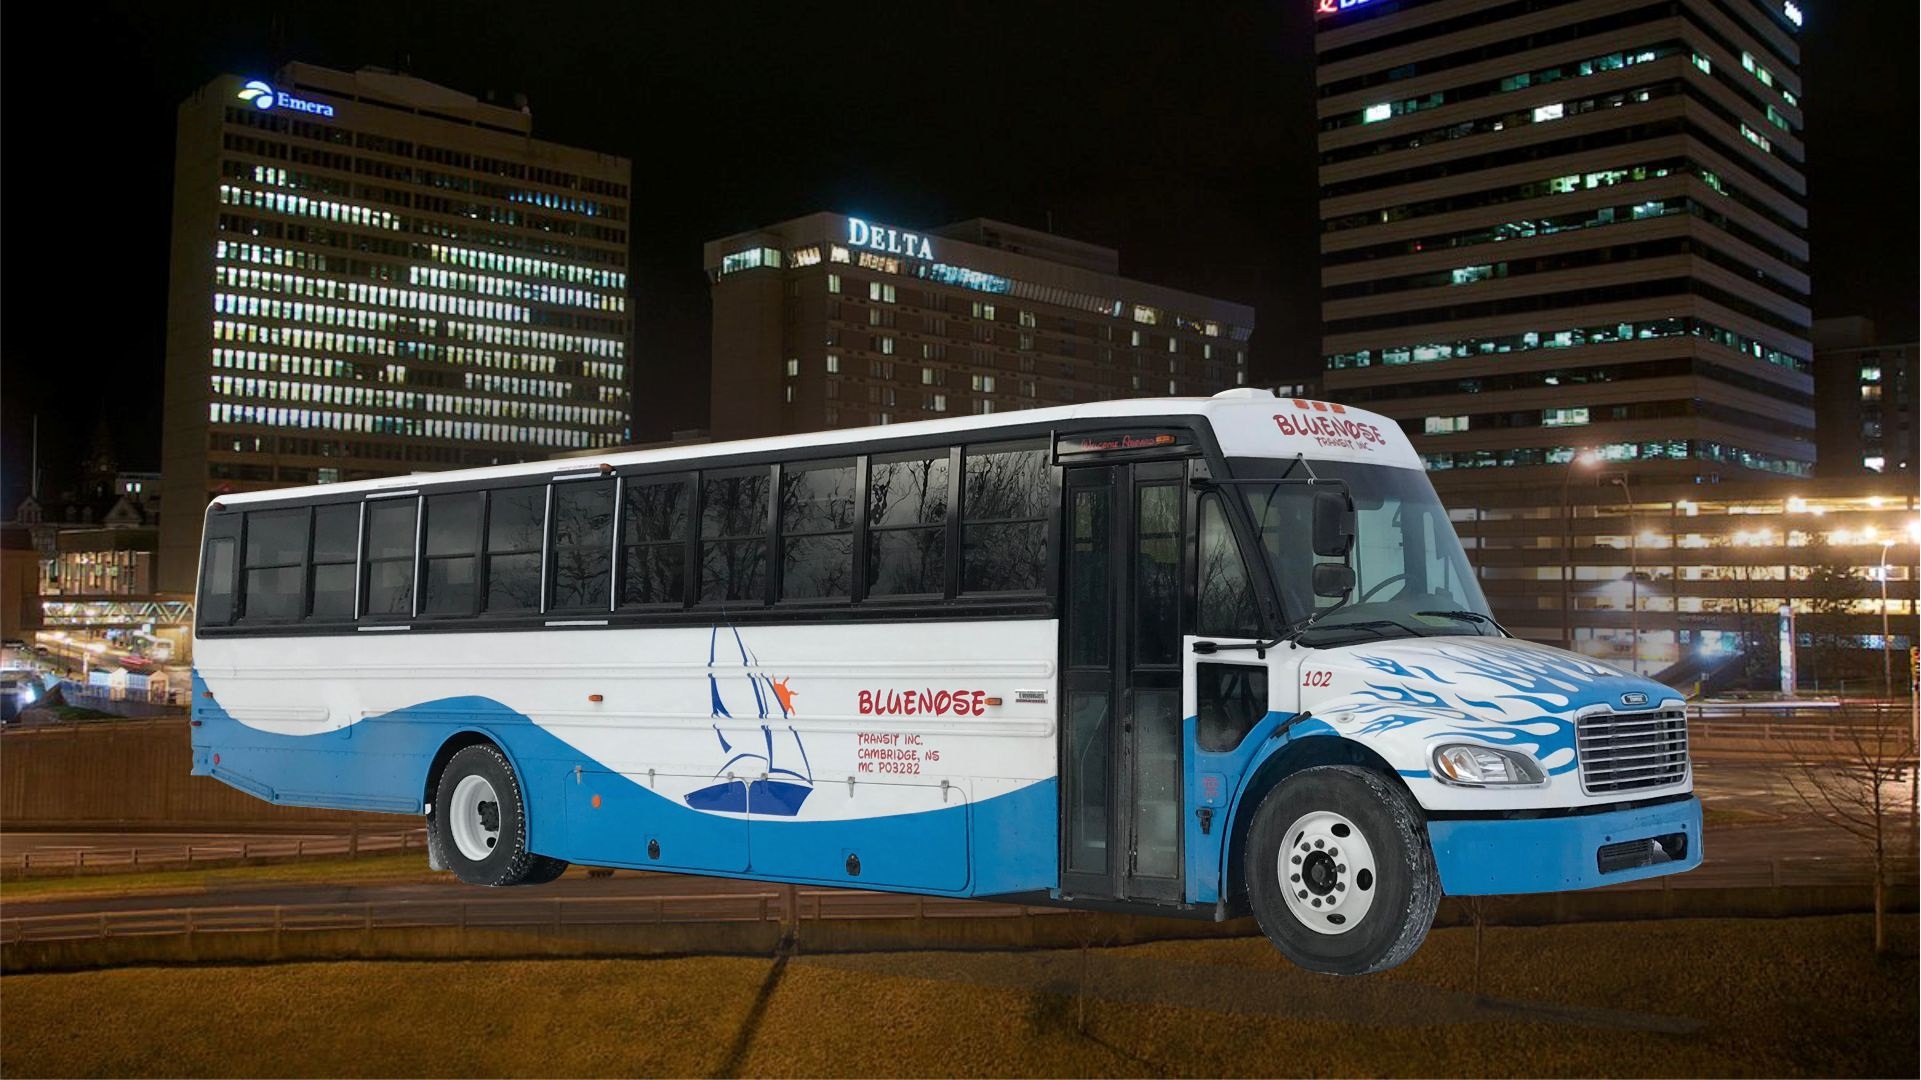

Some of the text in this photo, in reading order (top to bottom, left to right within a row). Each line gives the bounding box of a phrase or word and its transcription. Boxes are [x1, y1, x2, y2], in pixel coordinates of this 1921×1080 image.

[277, 91, 334, 116] Emera
[847, 217, 934, 260] DELTA
[1273, 414, 1386, 445] BLUENOSE
[1314, 437, 1355, 450] TRANSIT
[1302, 671, 1332, 687] 102
[857, 687, 986, 717] BLUENOSE
[857, 732, 924, 746] TRANSIT INC.
[857, 748, 940, 763] CAMBRIDGE, NS
[858, 762, 874, 773] MC
